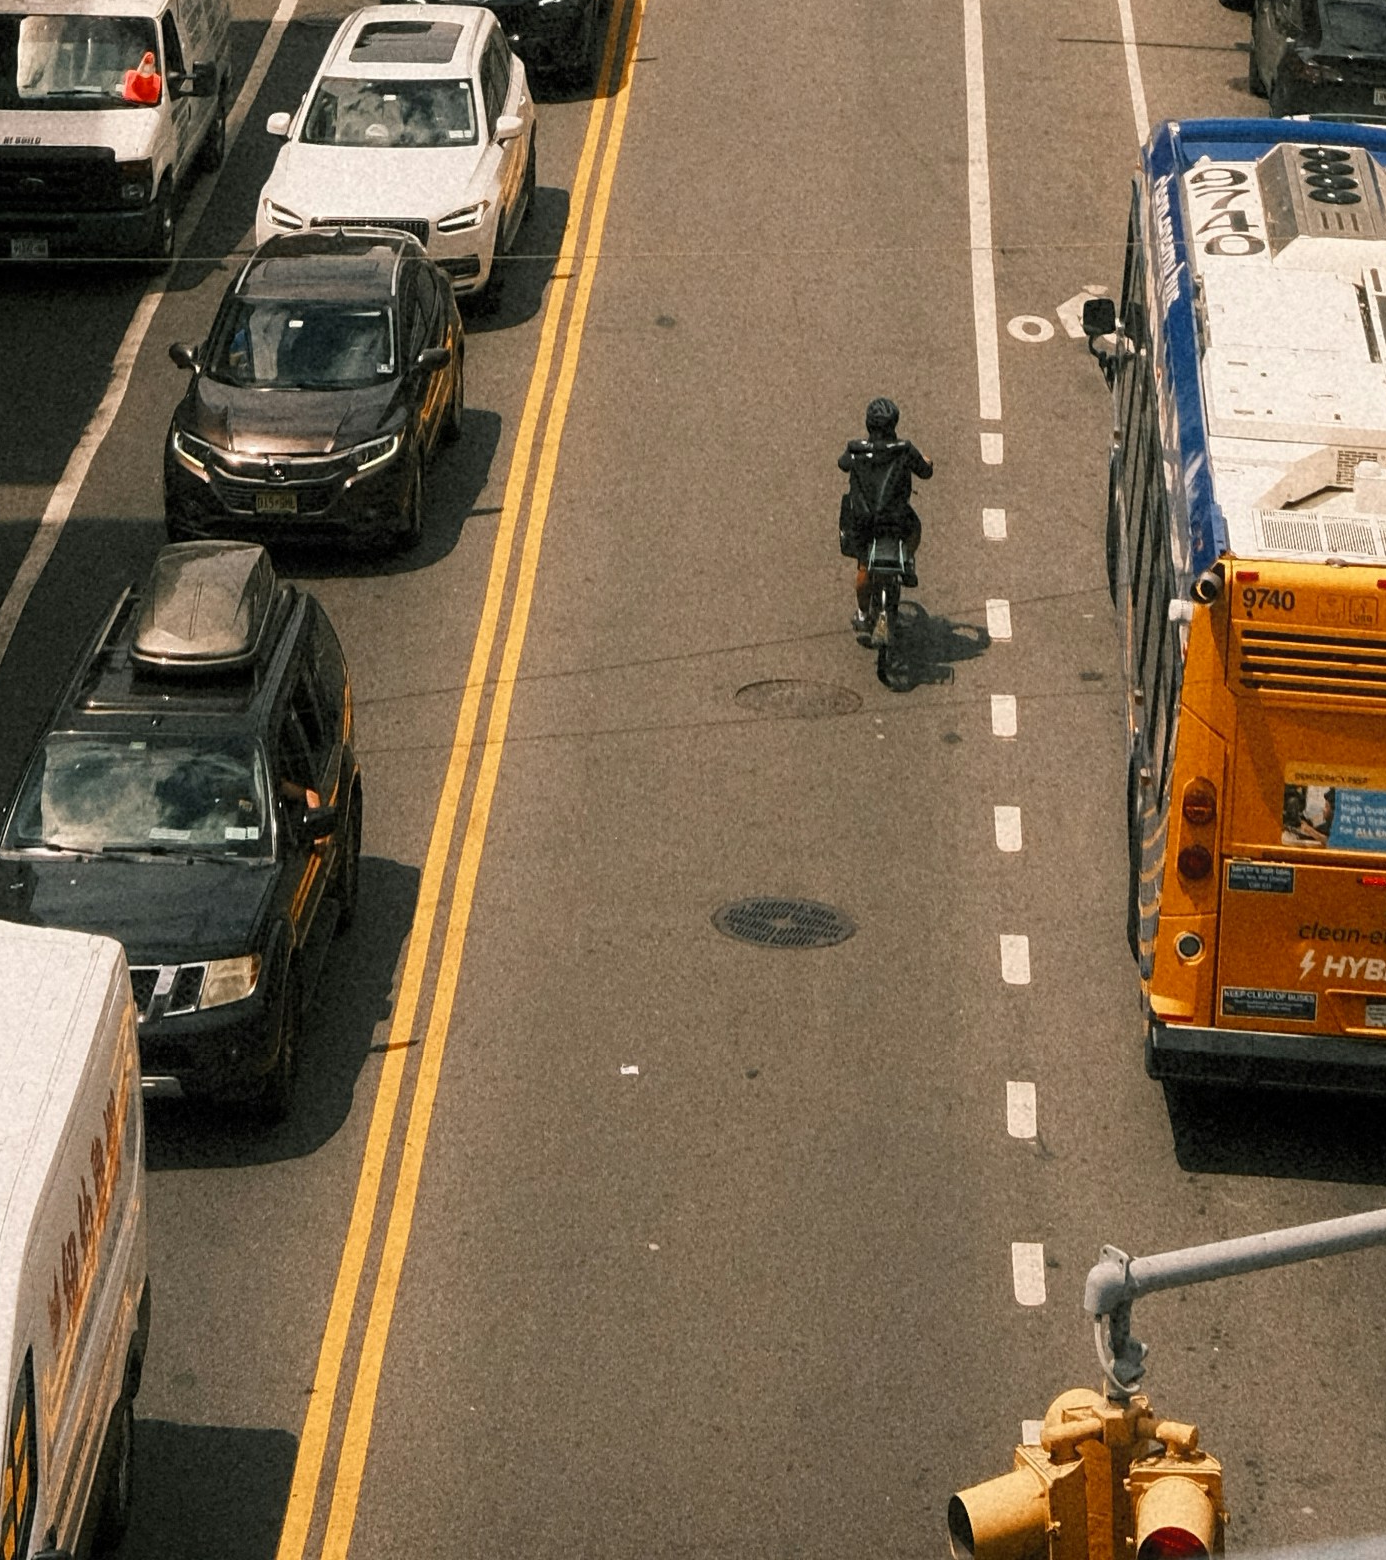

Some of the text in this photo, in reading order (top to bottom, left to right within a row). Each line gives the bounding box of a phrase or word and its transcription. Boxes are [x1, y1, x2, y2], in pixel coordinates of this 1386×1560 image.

[1188, 167, 1267, 258] 9740
[1241, 586, 1296, 612] 9740
[1340, 802, 1363, 815] High
[1247, 991, 1274, 1001] CLEAR
